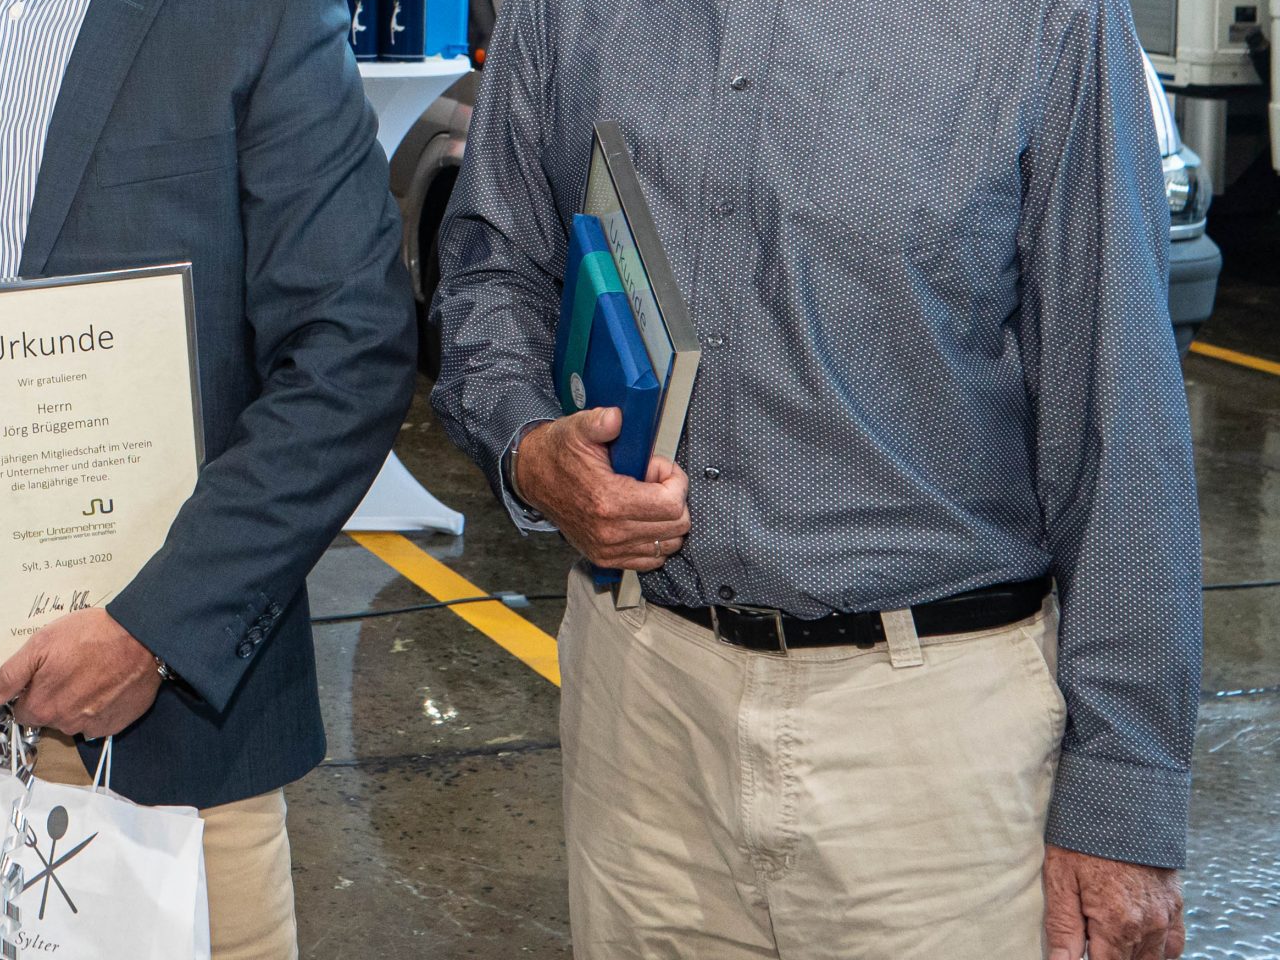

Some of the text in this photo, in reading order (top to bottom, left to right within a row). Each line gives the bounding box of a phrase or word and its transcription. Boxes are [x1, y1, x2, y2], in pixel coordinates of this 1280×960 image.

[17, 373, 87, 387] Wir gratulieren
[37, 402, 72, 415] Herrn
[3, 416, 110, 438] Jörg Brüggemann
[0, 452, 39, 466] jährigen
[41, 444, 107, 460] Mitgliedschaft
[108, 443, 120, 452] im
[122, 440, 153, 451] Verein
[6, 464, 69, 478] Unternehmer
[71, 460, 89, 471] und
[91, 457, 126, 468] danken
[127, 454, 142, 465] für
[11, 482, 26, 491] die
[28, 476, 79, 490] langjährige
[13, 521, 116, 541] Sylter Unternehmer
[55, 557, 87, 568] August
[89, 553, 113, 564] 2020
[15, 931, 60, 953] Sylter
